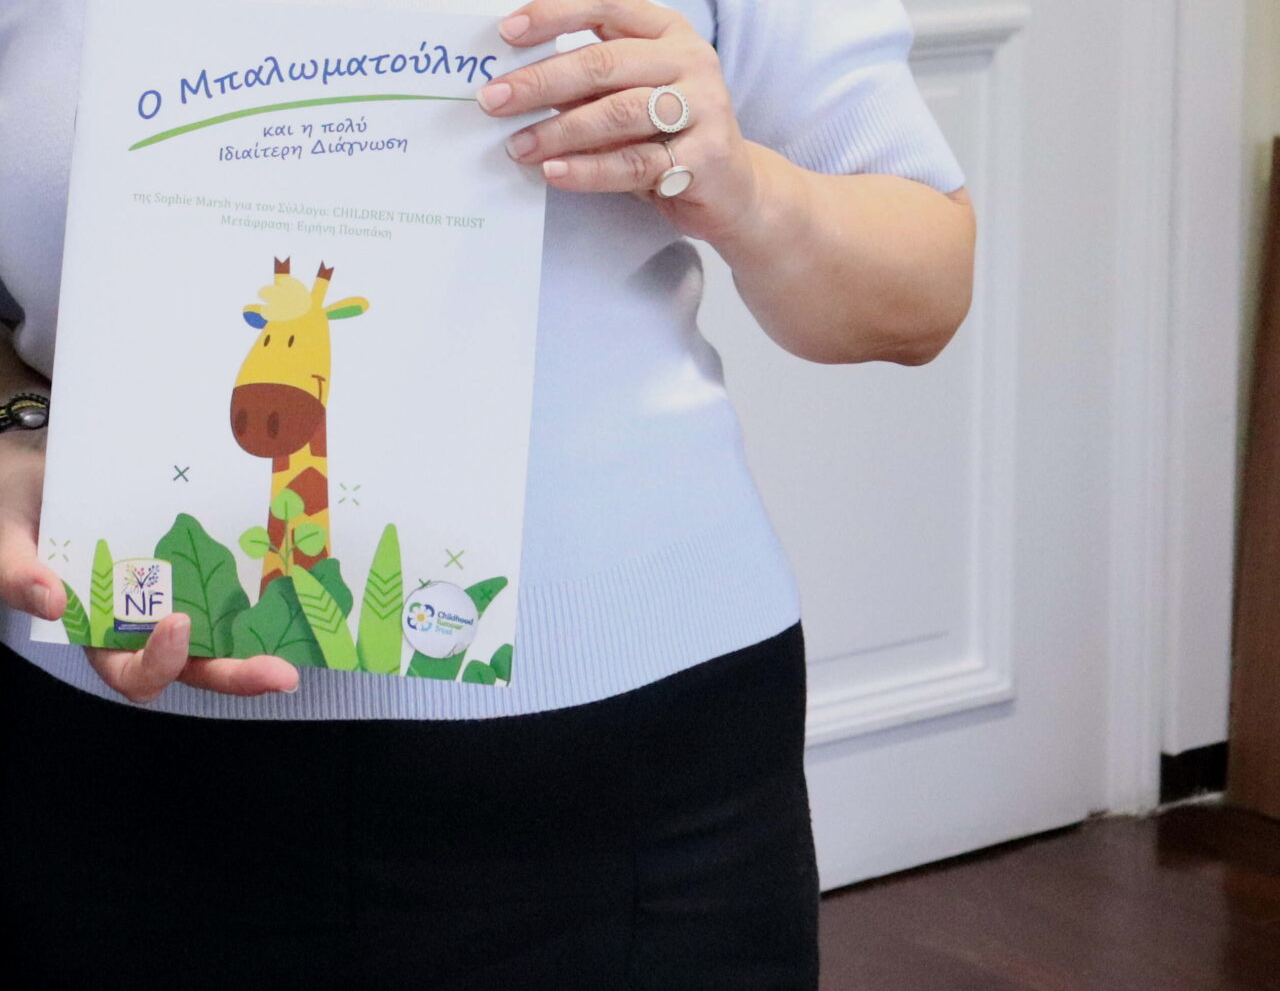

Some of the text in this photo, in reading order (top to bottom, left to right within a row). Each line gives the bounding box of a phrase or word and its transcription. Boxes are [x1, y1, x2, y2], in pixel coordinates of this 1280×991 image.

[138, 41, 497, 120] Ο Μπαλωματούλης
[263, 116, 367, 138] και η πολύ
[219, 137, 408, 162] Ιδιαίτερη Διάγνωση
[155, 192, 193, 206] Sophie
[196, 195, 231, 209] Marsh
[234, 200, 252, 211] για
[333, 206, 395, 221] CHILDREN
[396, 212, 442, 226] TUMOR
[445, 215, 486, 229] TRUST
[125, 591, 164, 616] NF
[437, 611, 474, 626] Childhood
